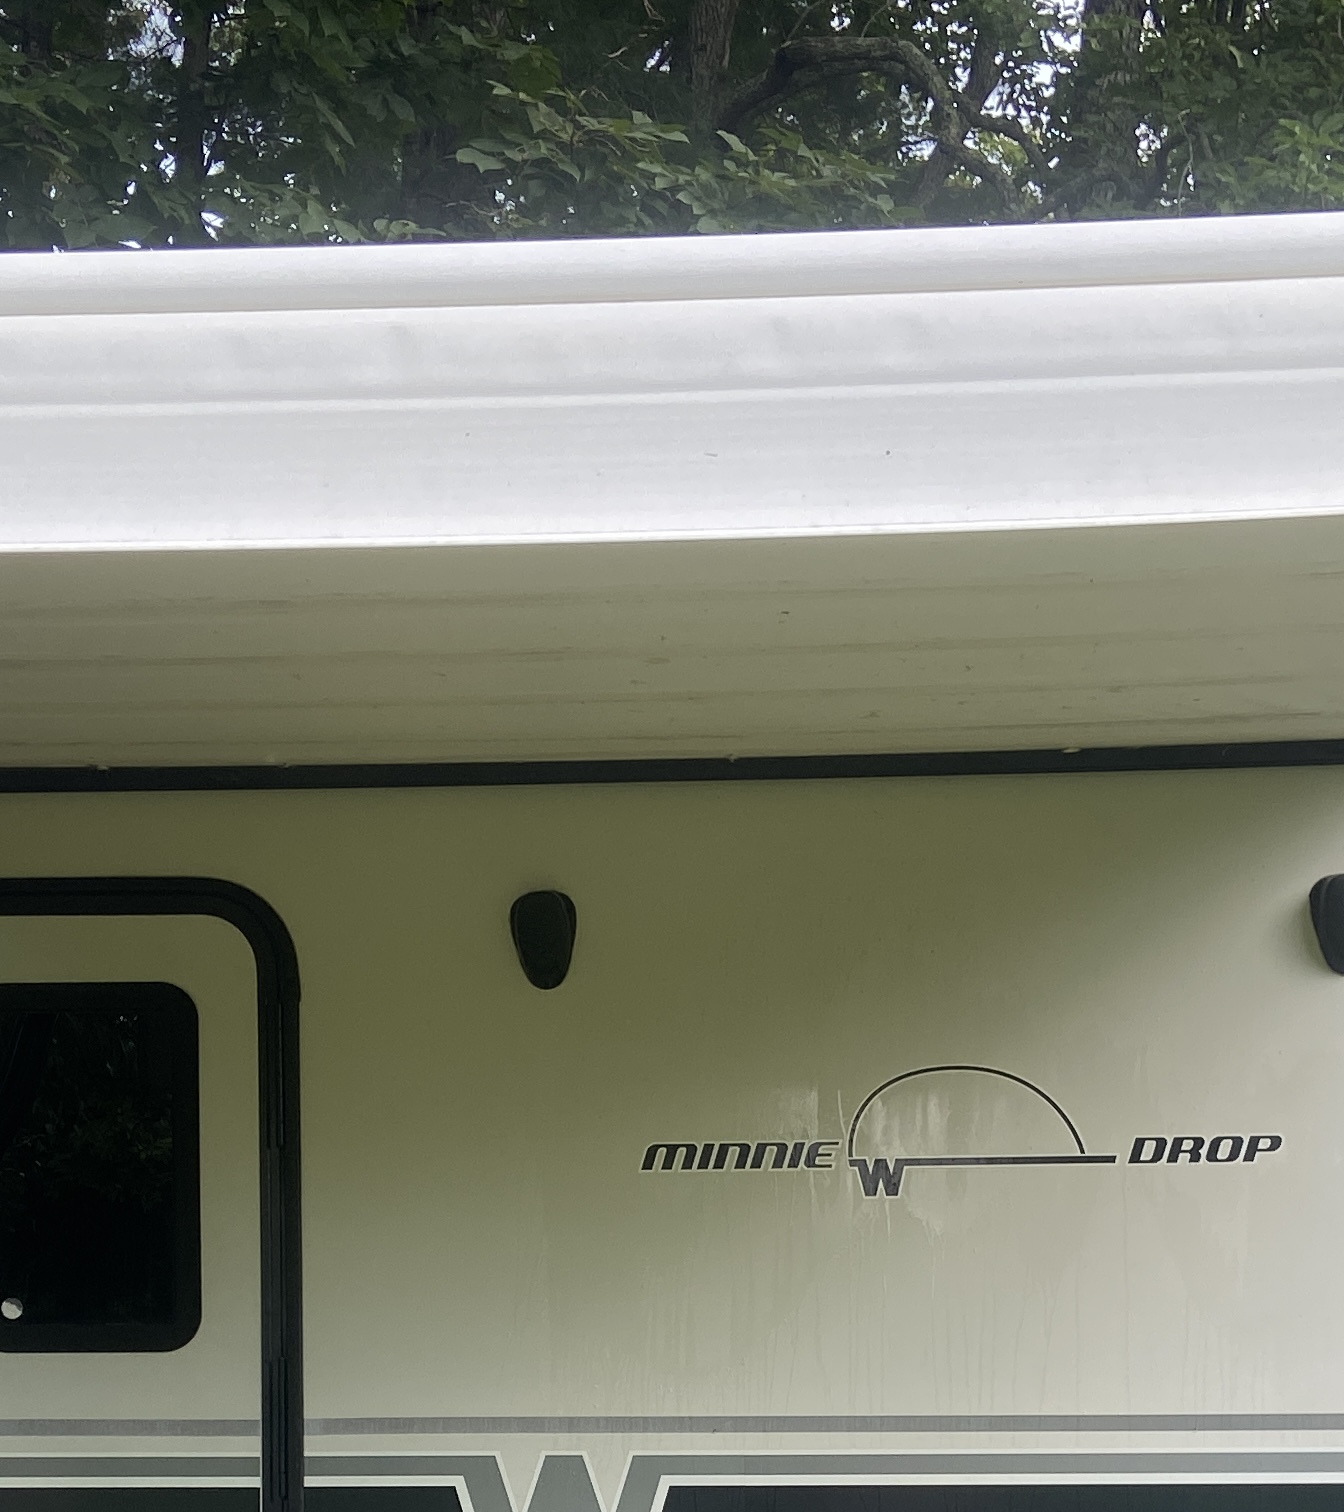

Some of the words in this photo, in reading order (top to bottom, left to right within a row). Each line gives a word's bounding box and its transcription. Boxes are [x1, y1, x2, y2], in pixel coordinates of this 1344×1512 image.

[641, 1141, 840, 1171] MINNIE
[1128, 1136, 1283, 1164] DROP
[855, 1158, 907, 1198] W
